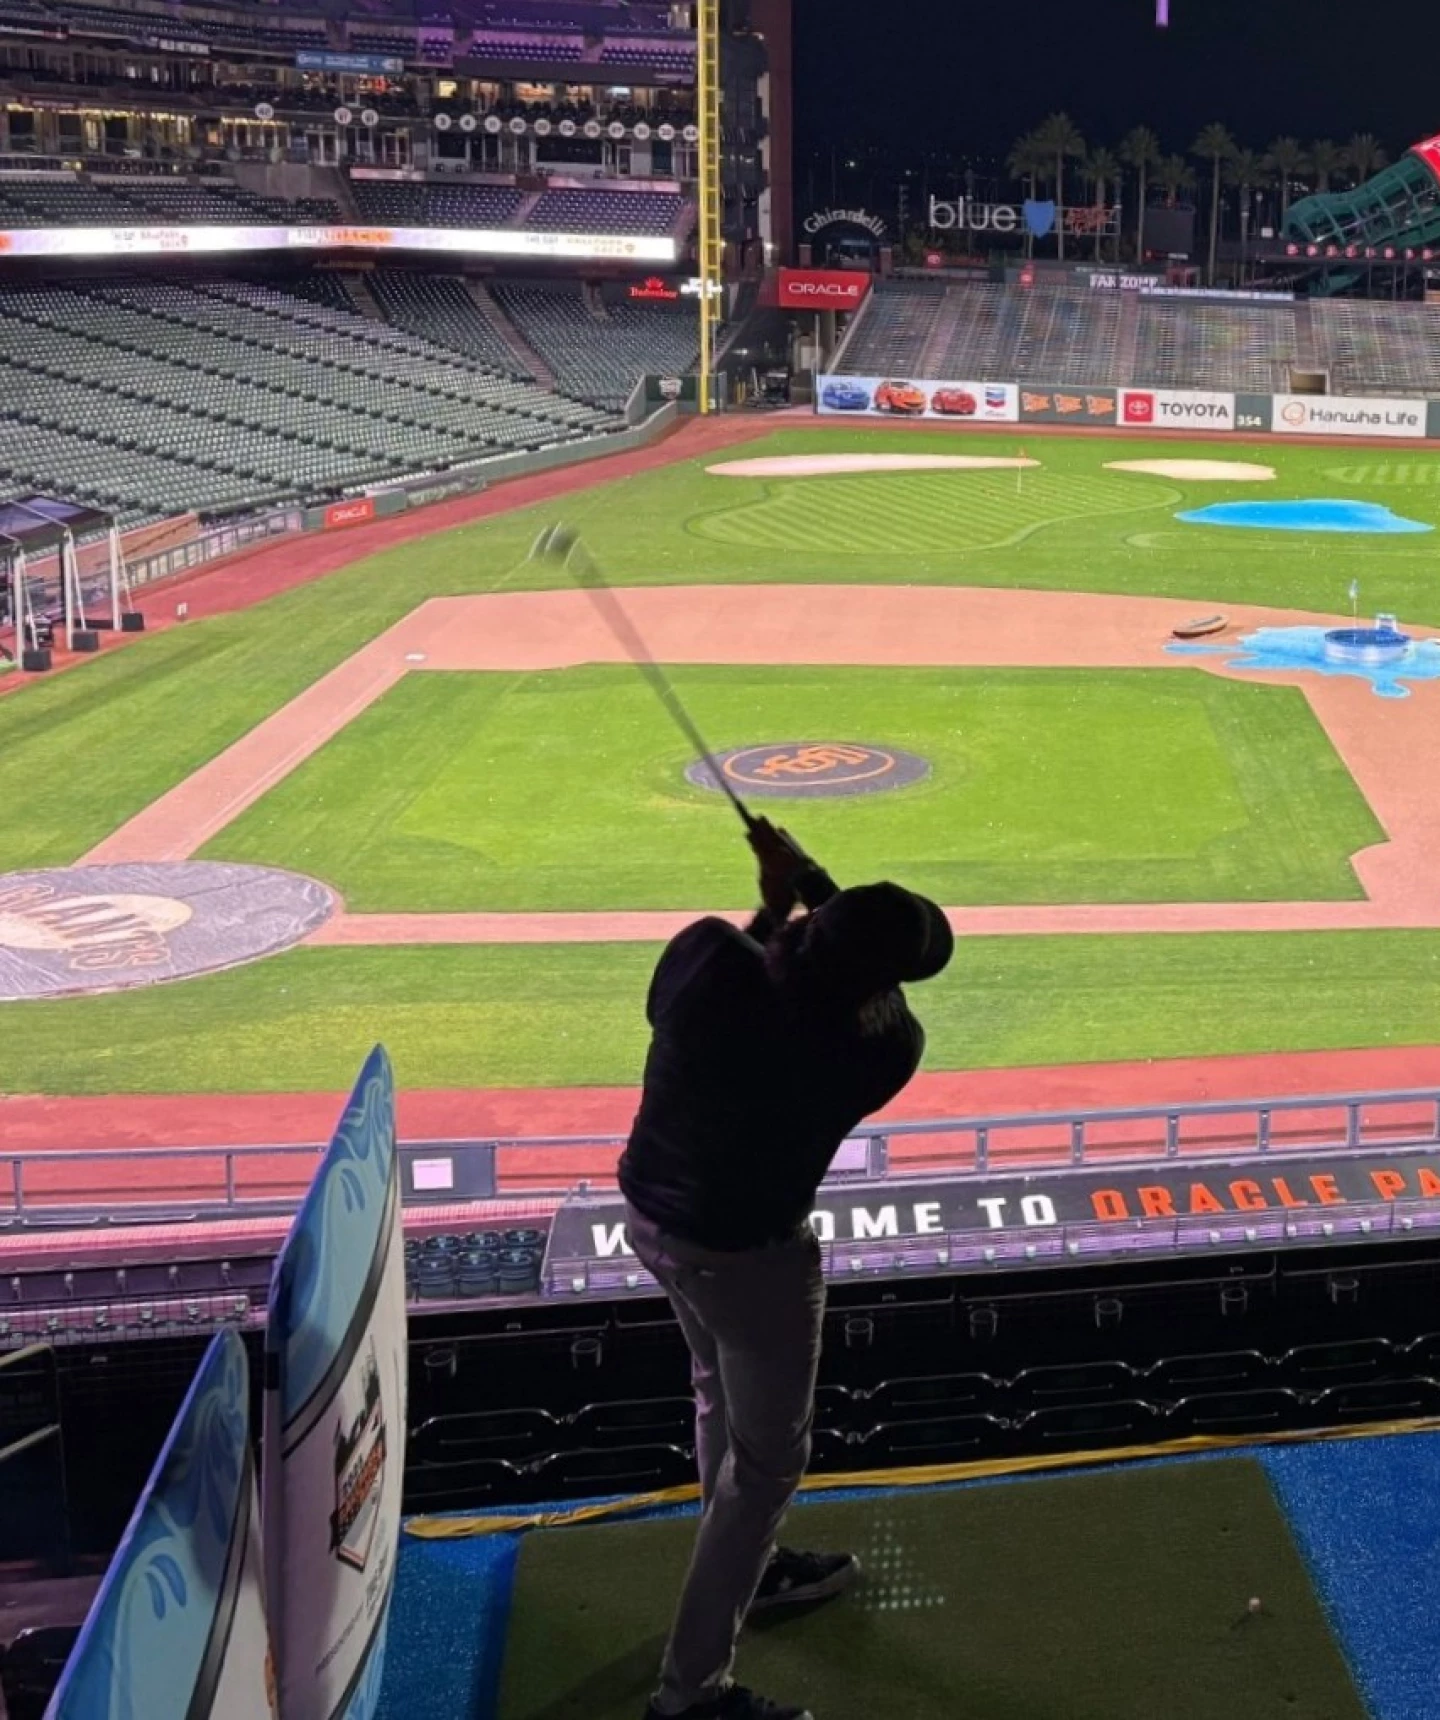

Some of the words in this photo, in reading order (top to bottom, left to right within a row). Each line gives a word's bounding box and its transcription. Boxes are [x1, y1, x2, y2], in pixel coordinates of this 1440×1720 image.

[803, 206, 889, 237] Ghirardelli
[928, 193, 1016, 232] blue
[788, 282, 858, 297] ORACLE
[1160, 402, 1229, 418] TOYOTA
[1309, 407, 1381, 425] Hanwha
[1385, 410, 1419, 427] Life
[1237, 415, 1262, 427] 354
[977, 1193, 1057, 1230] TO
[1088, 1173, 1347, 1222] ORACLE
